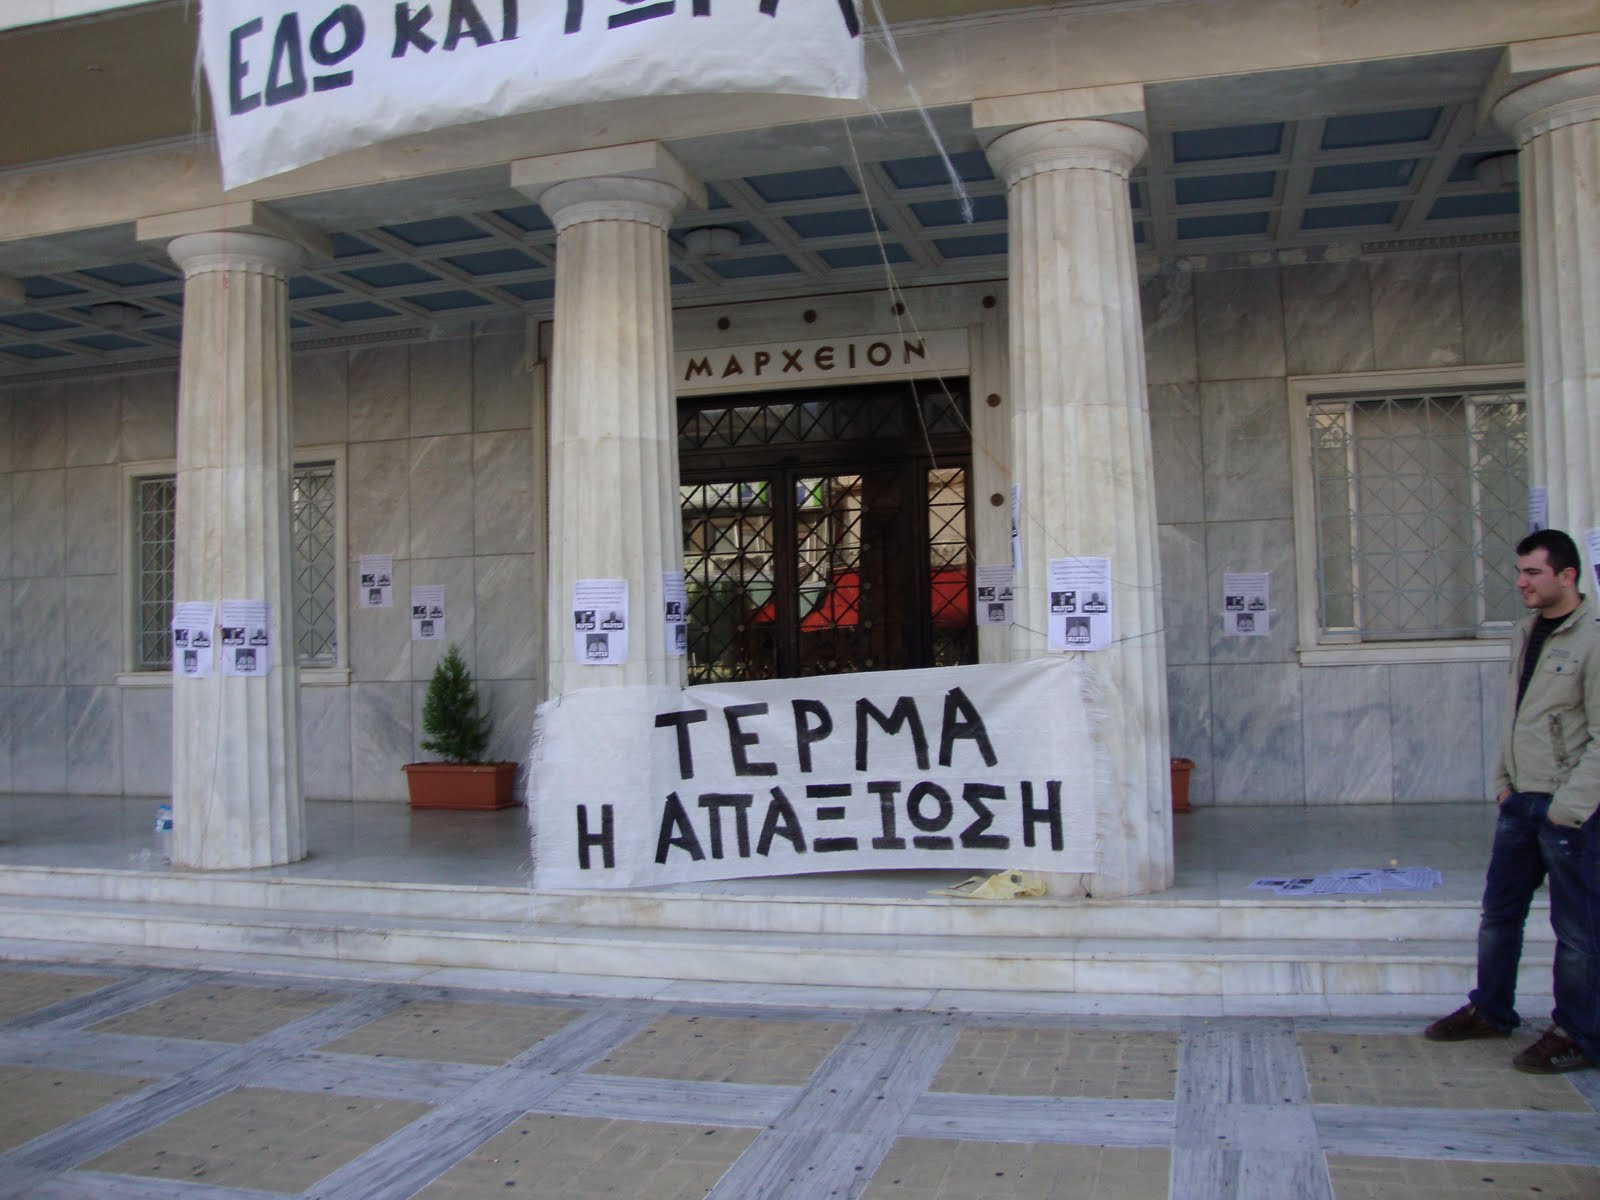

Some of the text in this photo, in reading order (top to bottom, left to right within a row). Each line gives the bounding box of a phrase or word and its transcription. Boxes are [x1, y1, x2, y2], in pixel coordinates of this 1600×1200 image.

[229, 2, 366, 116] ΕΔΩ
[391, 0, 519, 58] ΚΑΙ
[684, 338, 926, 381] ΜΑΡΧΕΙΟΝ
[654, 686, 998, 779] ΤΕΡΜΑ
[577, 780, 1063, 869] Η ΑΠΑΞΙΩΣΗ
